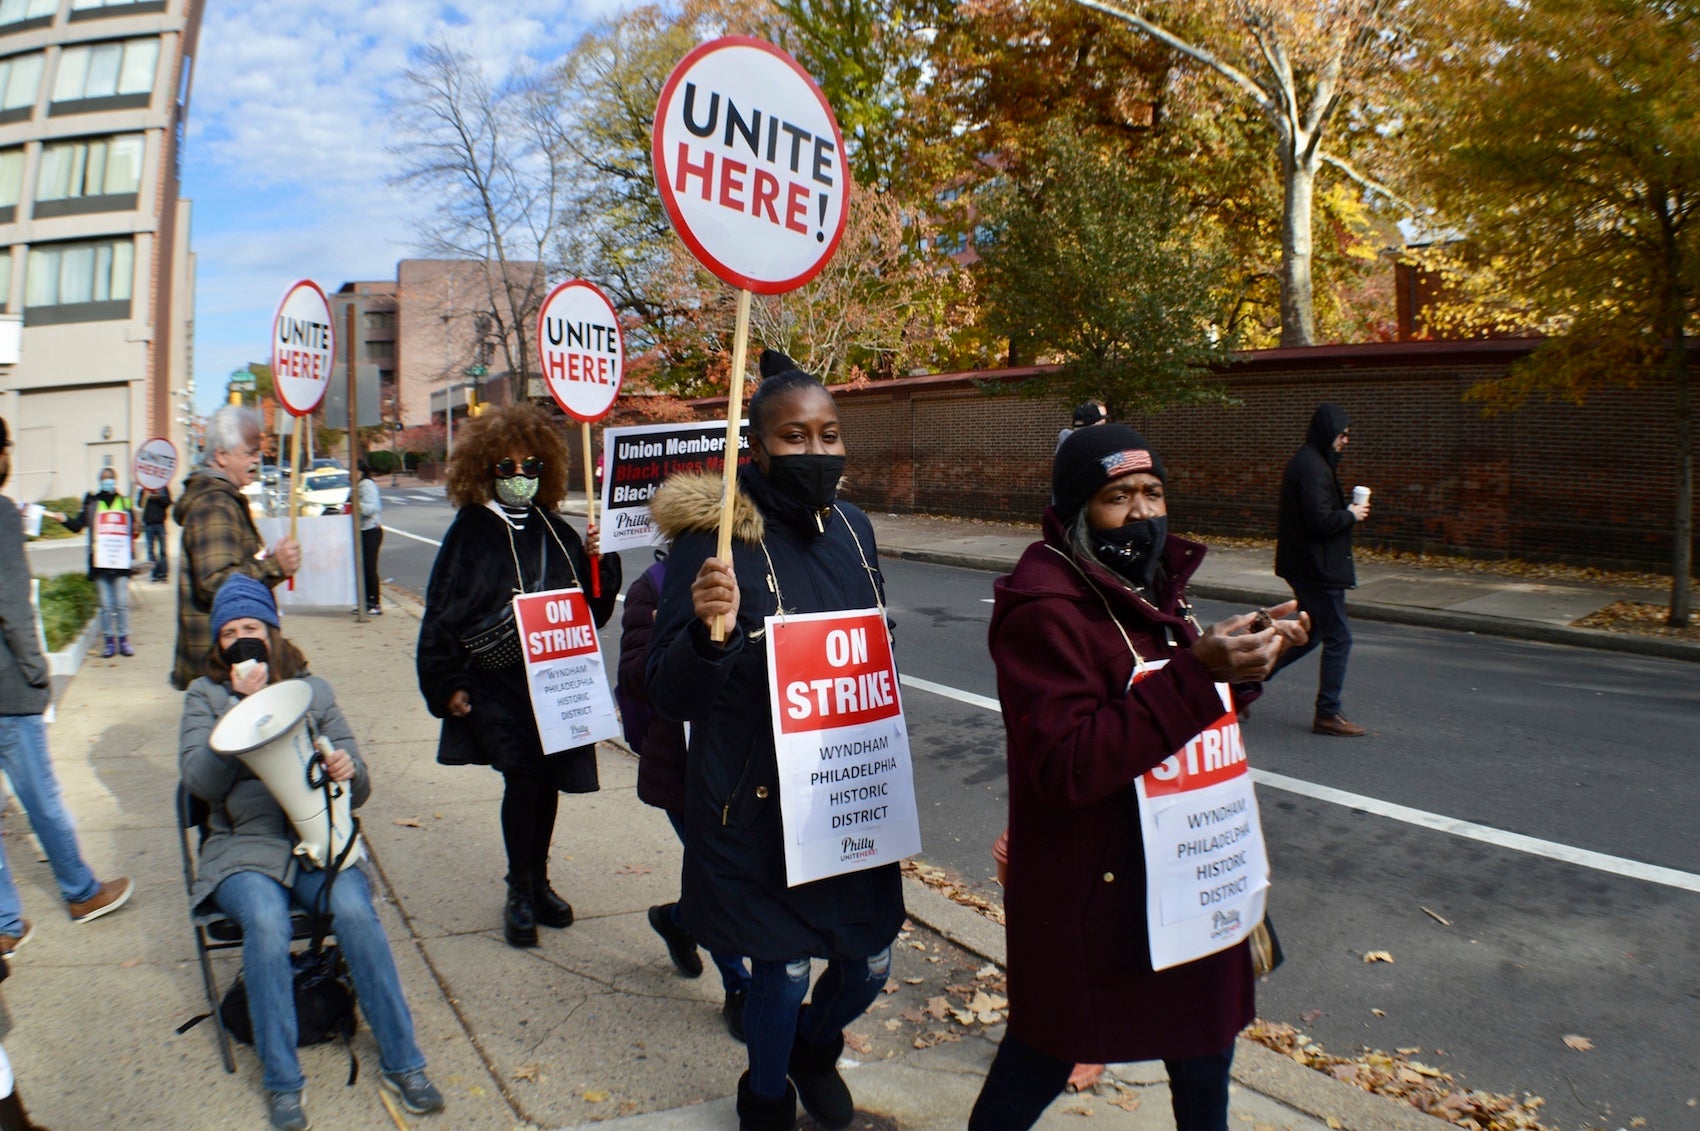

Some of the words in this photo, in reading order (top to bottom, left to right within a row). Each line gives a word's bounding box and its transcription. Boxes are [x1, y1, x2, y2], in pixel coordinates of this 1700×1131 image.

[682, 81, 835, 187] UNITE
[675, 141, 829, 243] HERE!
[279, 315, 329, 350] UNITE
[546, 316, 617, 354] UNITE
[278, 348, 327, 381] HERE!
[548, 351, 616, 387] HERE!
[618, 438, 663, 460] Union
[665, 434, 726, 456] Member
[615, 461, 660, 482] Black
[613, 483, 657, 503] Black
[545, 599, 574, 624] ON
[528, 624, 594, 656] STRIKE
[825, 627, 869, 668] ON
[544, 677, 595, 694] PHILADELPHIA
[547, 664, 588, 680] WYNDHAM
[557, 692, 590, 706] HISTORIC
[785, 669, 894, 720] STRIKE
[561, 705, 592, 720] DISTRICT
[819, 735, 889, 761] WYNDHAM
[1150, 722, 1247, 781] STRIK
[810, 757, 897, 785] PHILADELPHIA
[829, 782, 889, 806] HISTORIC
[832, 805, 889, 829] DISTRICT
[841, 836, 875, 853] Philly
[1196, 849, 1247, 881] HISTORIC
[1199, 875, 1248, 906] DISTRICT
